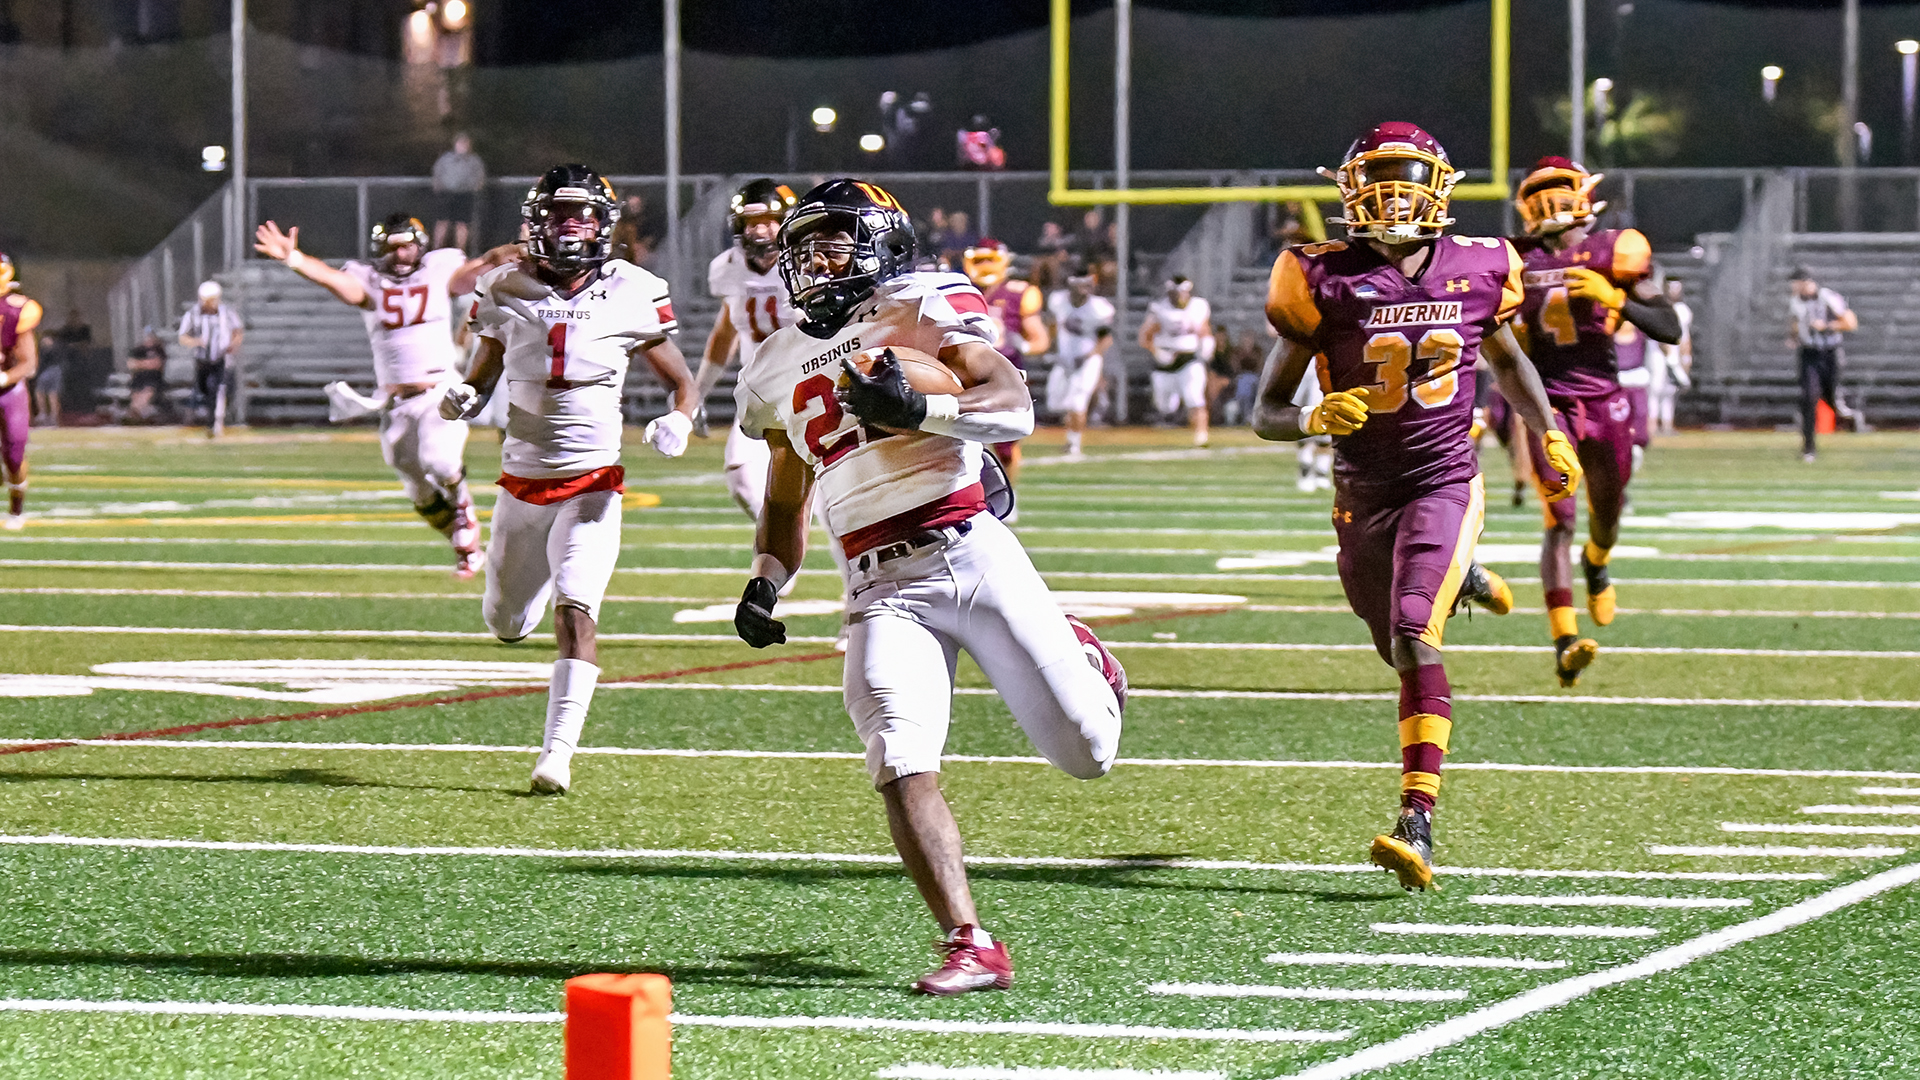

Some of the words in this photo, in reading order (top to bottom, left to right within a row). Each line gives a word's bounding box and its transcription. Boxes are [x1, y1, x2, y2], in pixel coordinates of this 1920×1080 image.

[382, 284, 428, 330] 57
[537, 309, 592, 320] URSINUS
[1370, 304, 1459, 326] ALVERNIA
[1540, 286, 1579, 346] 4
[545, 322, 573, 390] 1
[801, 337, 862, 375] URSINUS
[1361, 328, 1466, 414] 33
